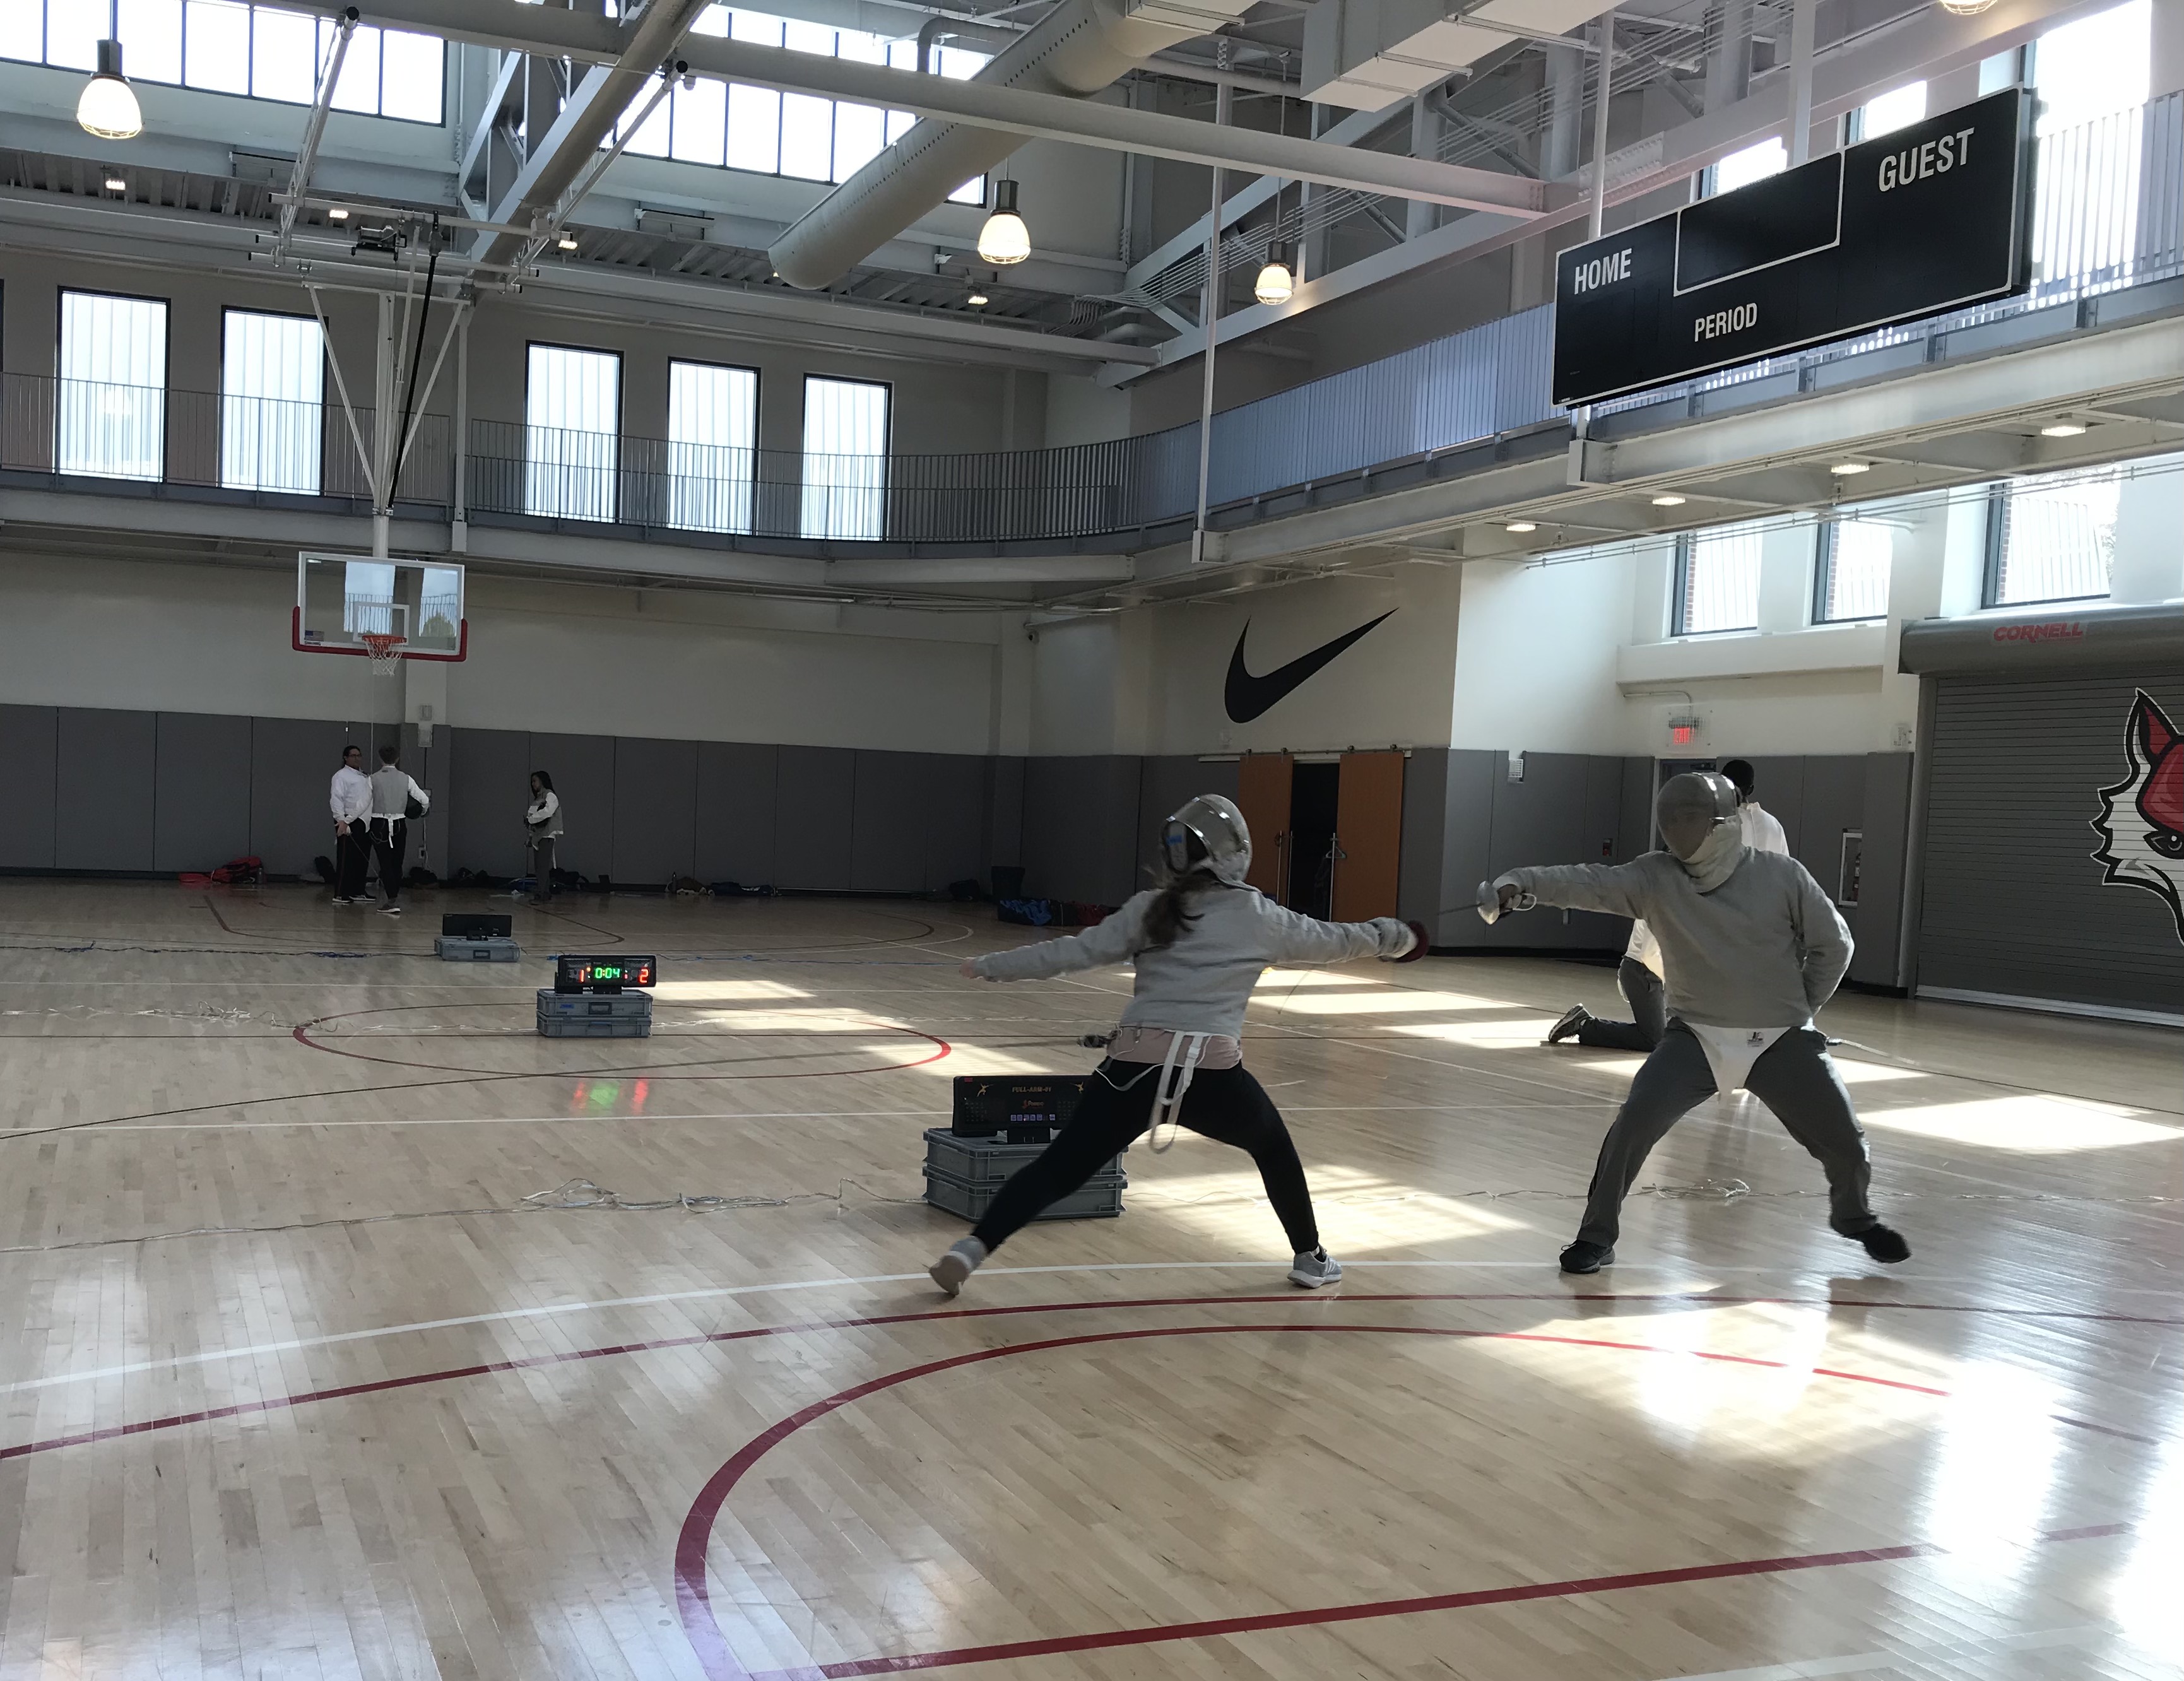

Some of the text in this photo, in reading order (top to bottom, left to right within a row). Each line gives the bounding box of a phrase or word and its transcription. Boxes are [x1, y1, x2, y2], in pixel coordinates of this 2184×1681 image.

[1877, 127, 1975, 192] GUEST
[1573, 248, 1632, 295] HOME
[1694, 302, 1758, 342] PERIOD
[1993, 622, 2083, 643] CORNELL
[594, 967, 621, 979] 0:04
[639, 968, 650, 984] 2
